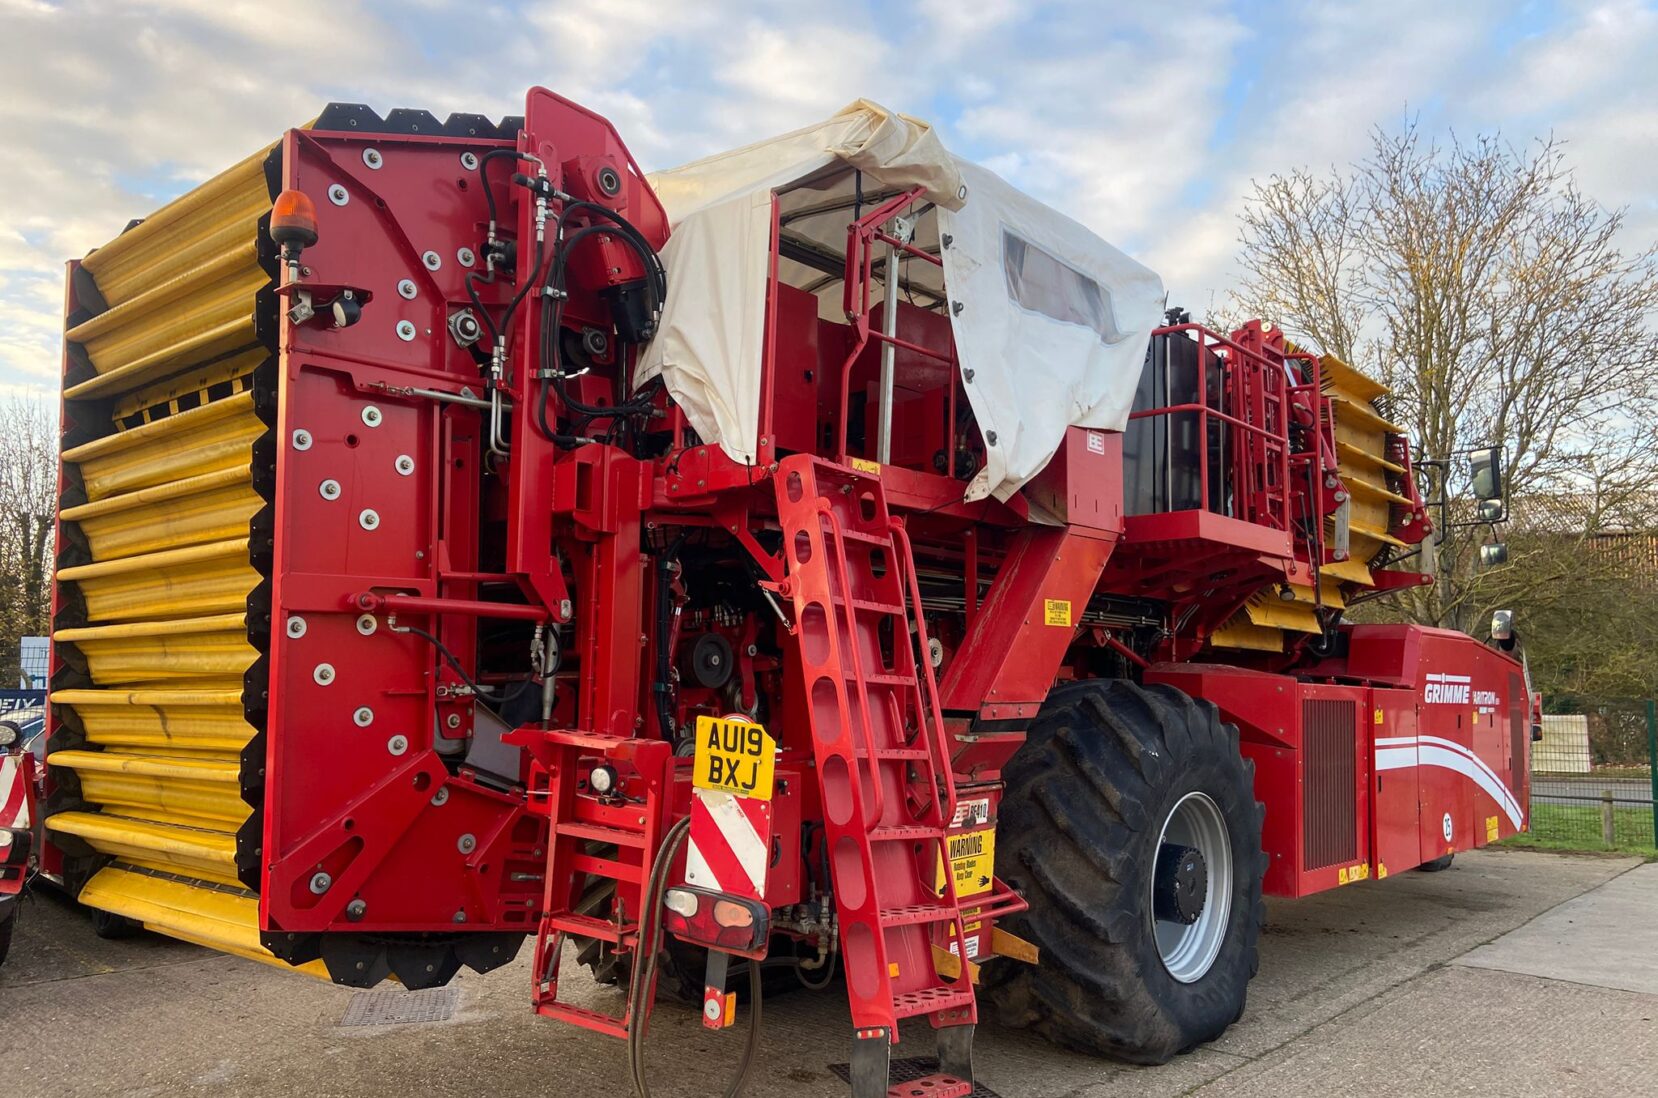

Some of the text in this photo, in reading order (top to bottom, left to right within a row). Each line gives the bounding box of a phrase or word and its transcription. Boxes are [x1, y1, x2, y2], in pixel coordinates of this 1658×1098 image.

[1425, 683, 1470, 704] GRIMME
[708, 723, 763, 756] AU19
[708, 755, 758, 790] BXJ
[950, 835, 982, 858] WARNING
